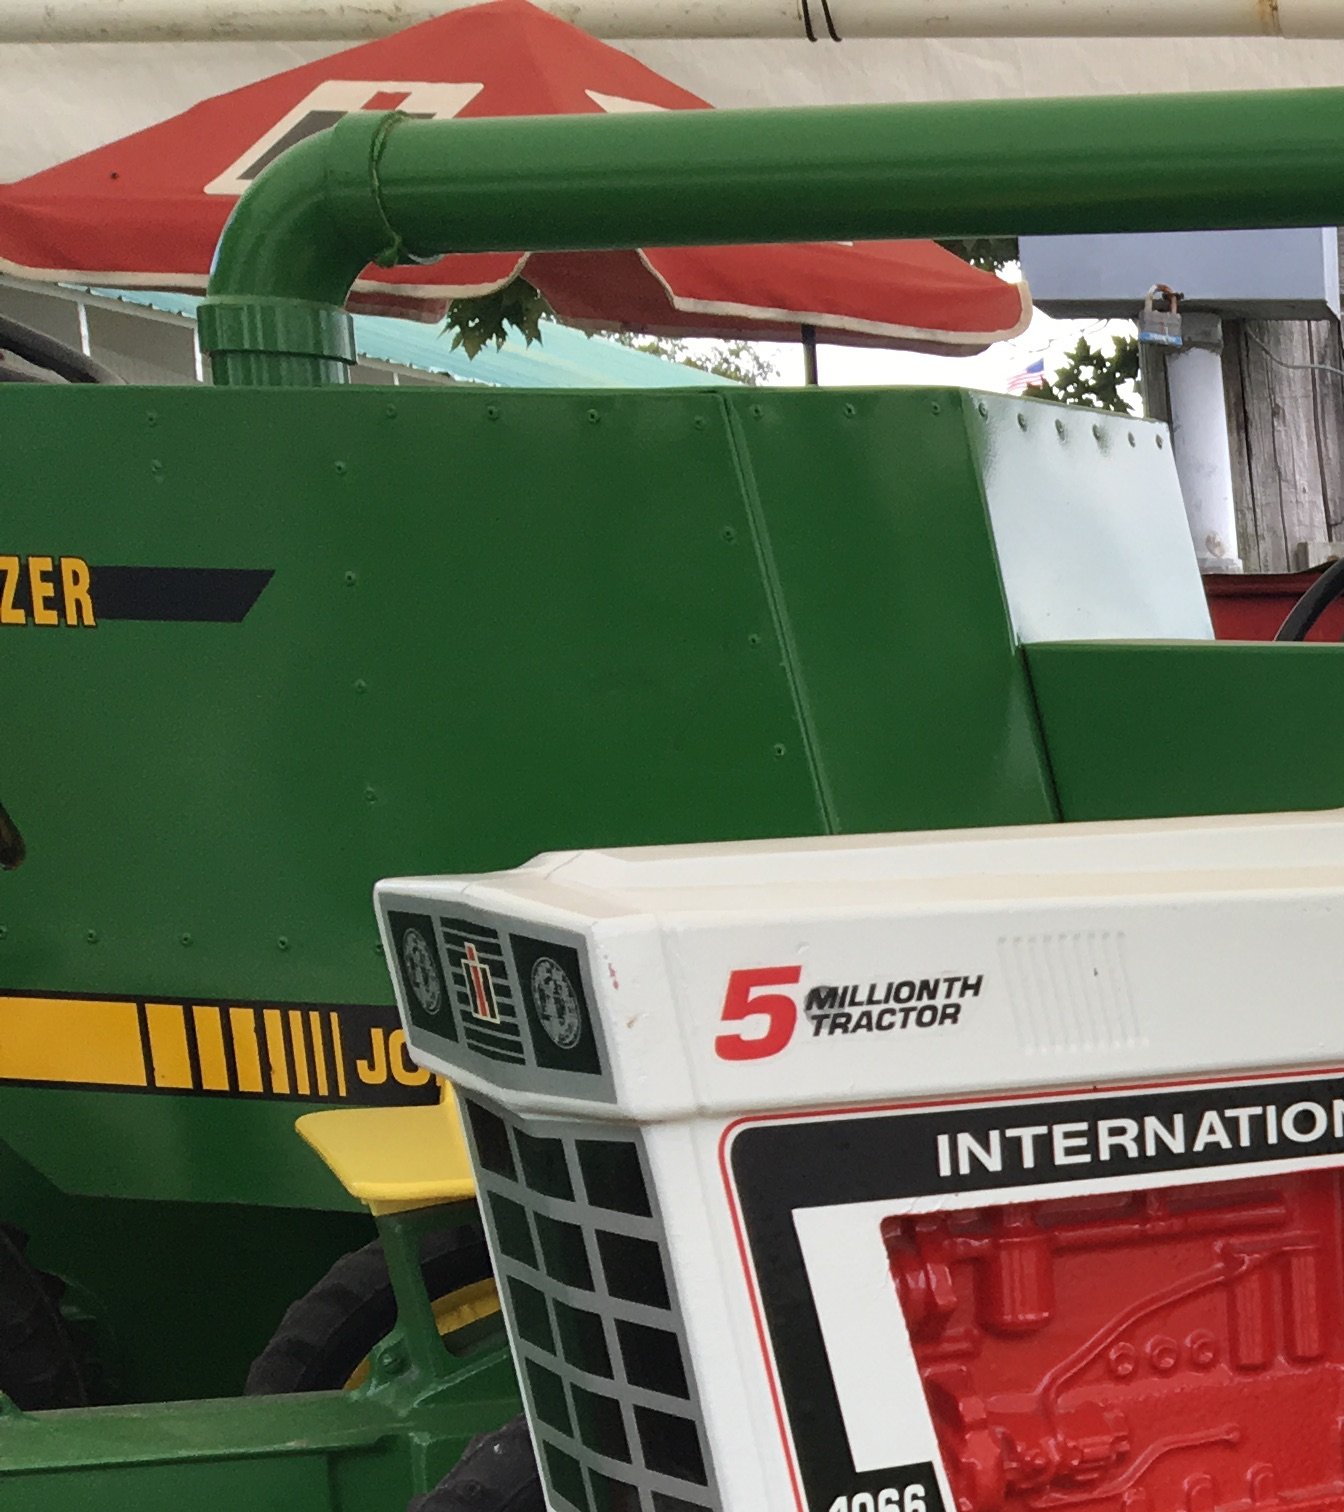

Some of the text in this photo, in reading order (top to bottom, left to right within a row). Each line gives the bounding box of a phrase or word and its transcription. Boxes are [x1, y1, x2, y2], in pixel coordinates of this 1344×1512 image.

[715, 965, 984, 1061] 5 MILLIONTH
[812, 1002, 962, 1037] TRACTOR
[356, 1028, 444, 1087] JO
